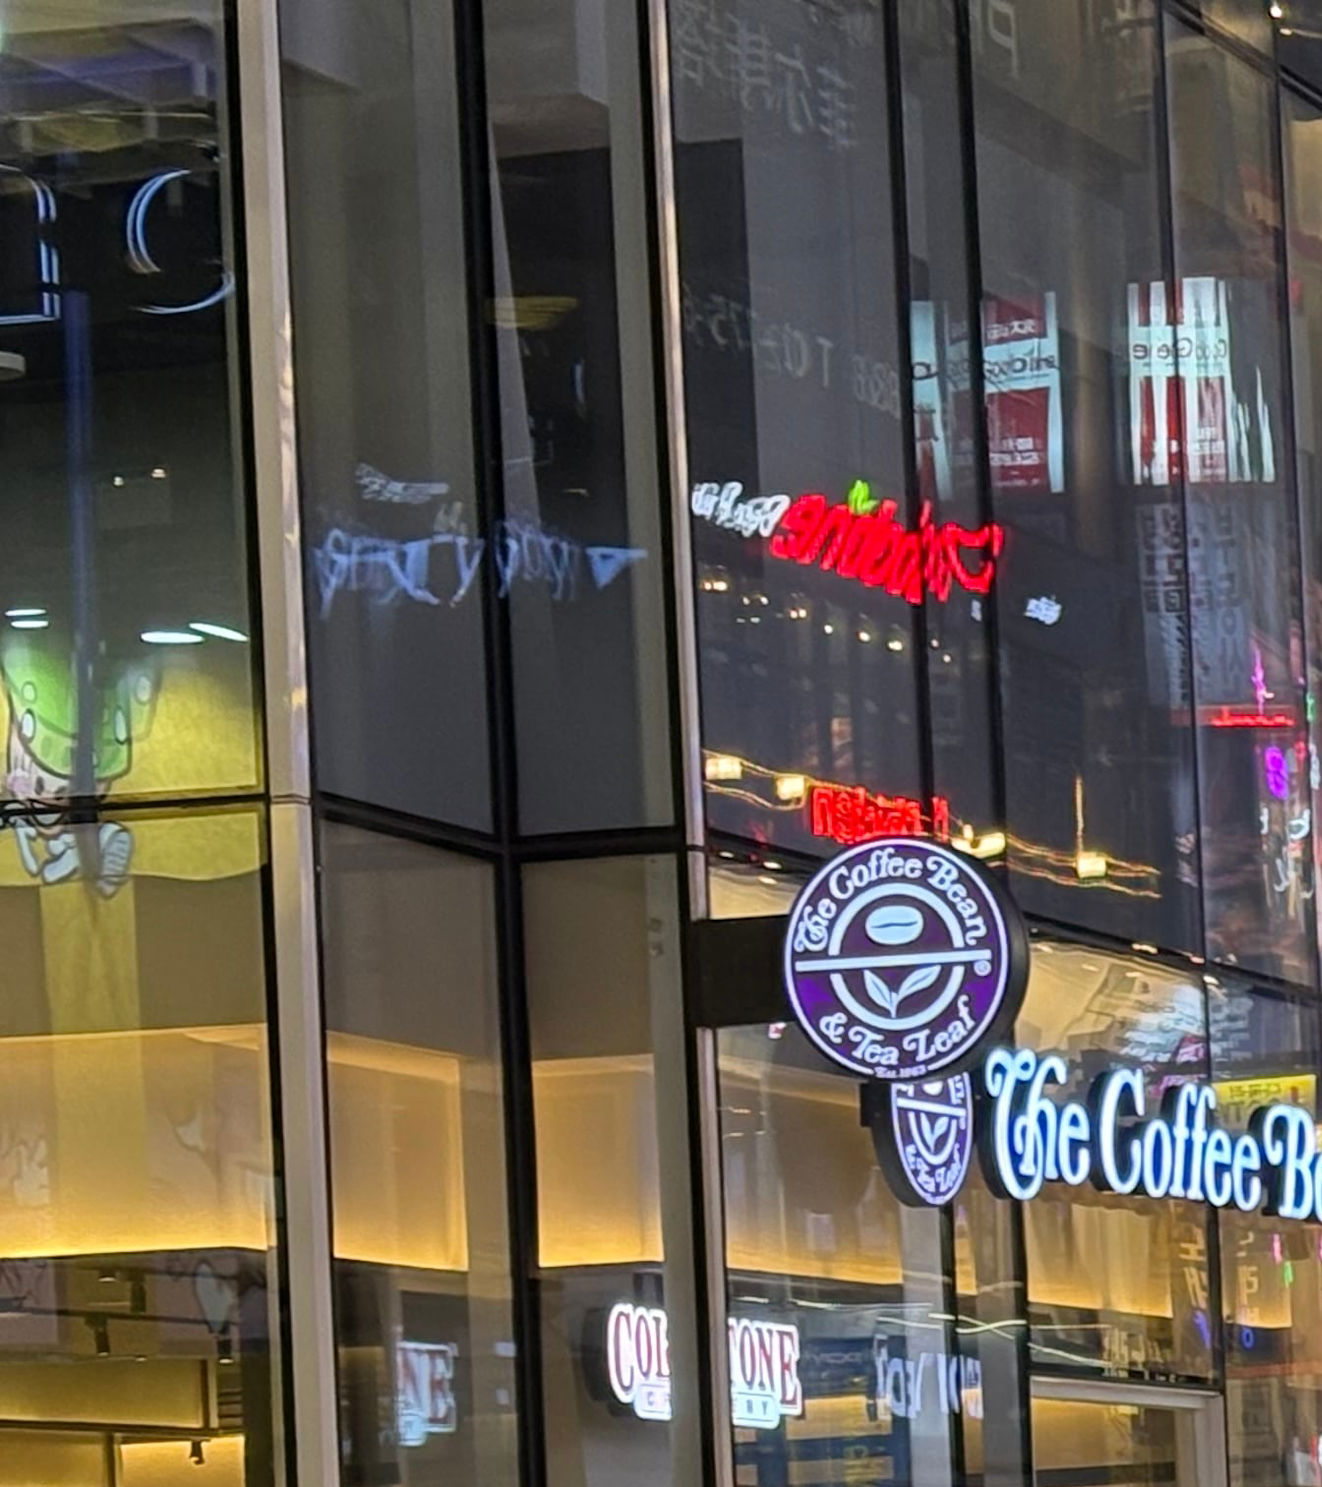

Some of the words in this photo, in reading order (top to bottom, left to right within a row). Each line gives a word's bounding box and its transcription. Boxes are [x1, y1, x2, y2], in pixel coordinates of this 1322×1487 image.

[793, 896, 837, 953] The
[827, 847, 923, 901] Coffee
[926, 854, 988, 947] Bean
[819, 1011, 848, 1044] &
[848, 1027, 900, 1066] Tea
[902, 994, 977, 1062] Leaf
[984, 1047, 1090, 1201] The
[1100, 1068, 1262, 1212] Coffee
